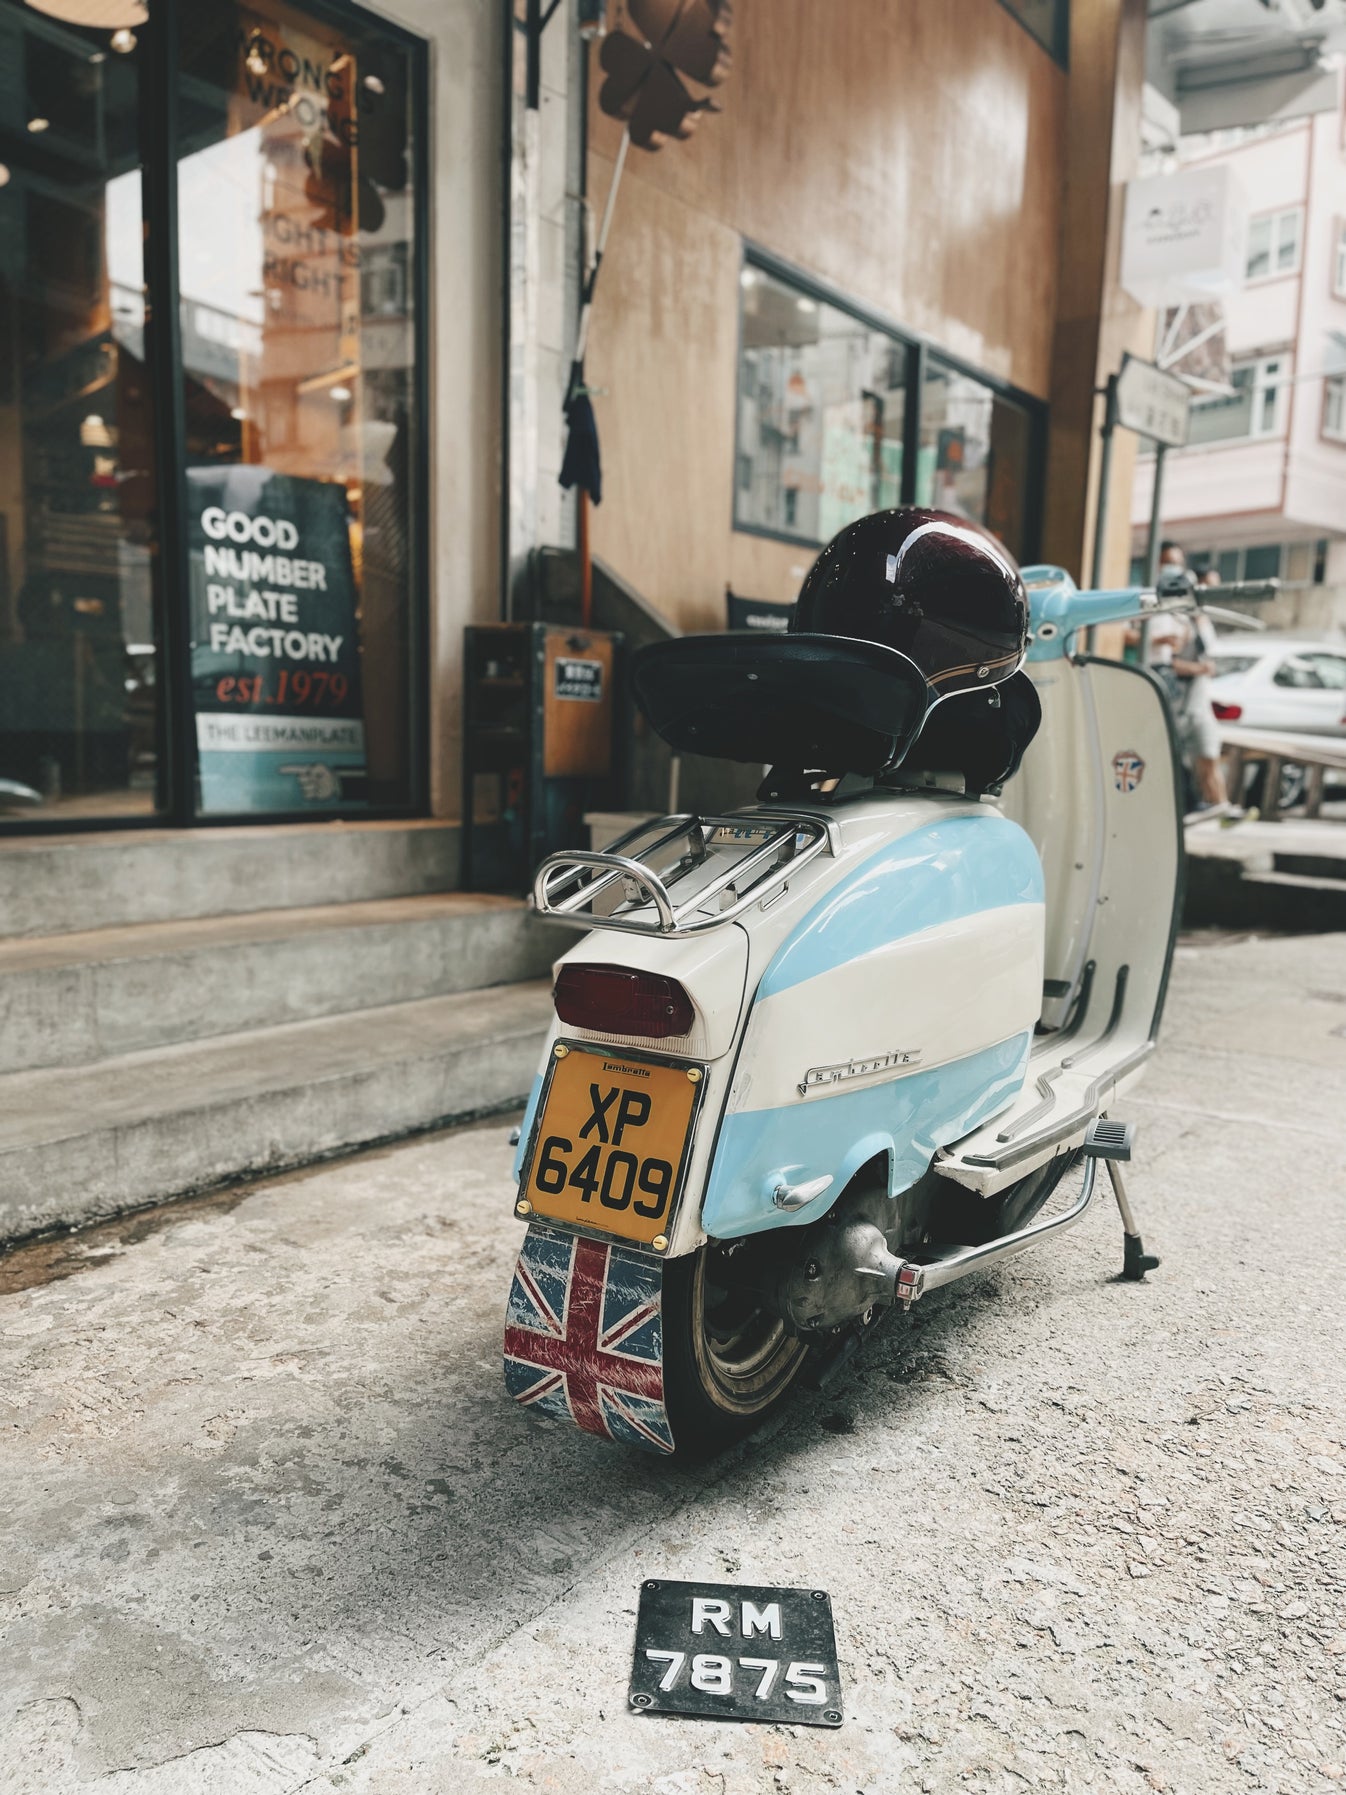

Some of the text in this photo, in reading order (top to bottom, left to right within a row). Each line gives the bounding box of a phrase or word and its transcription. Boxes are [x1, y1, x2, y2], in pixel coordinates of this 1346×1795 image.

[201, 506, 299, 550] GOOD
[204, 545, 327, 591] NUMBER
[207, 584, 299, 623] PLATE
[210, 623, 343, 662] FACTORY
[207, 724, 358, 744] THE LEEMANPLATE
[602, 1061, 650, 1078] Lambretta
[579, 1083, 651, 1146] XP
[536, 1136, 672, 1219] 6409
[691, 1598, 782, 1640] RM
[646, 1649, 827, 1705] 7875
